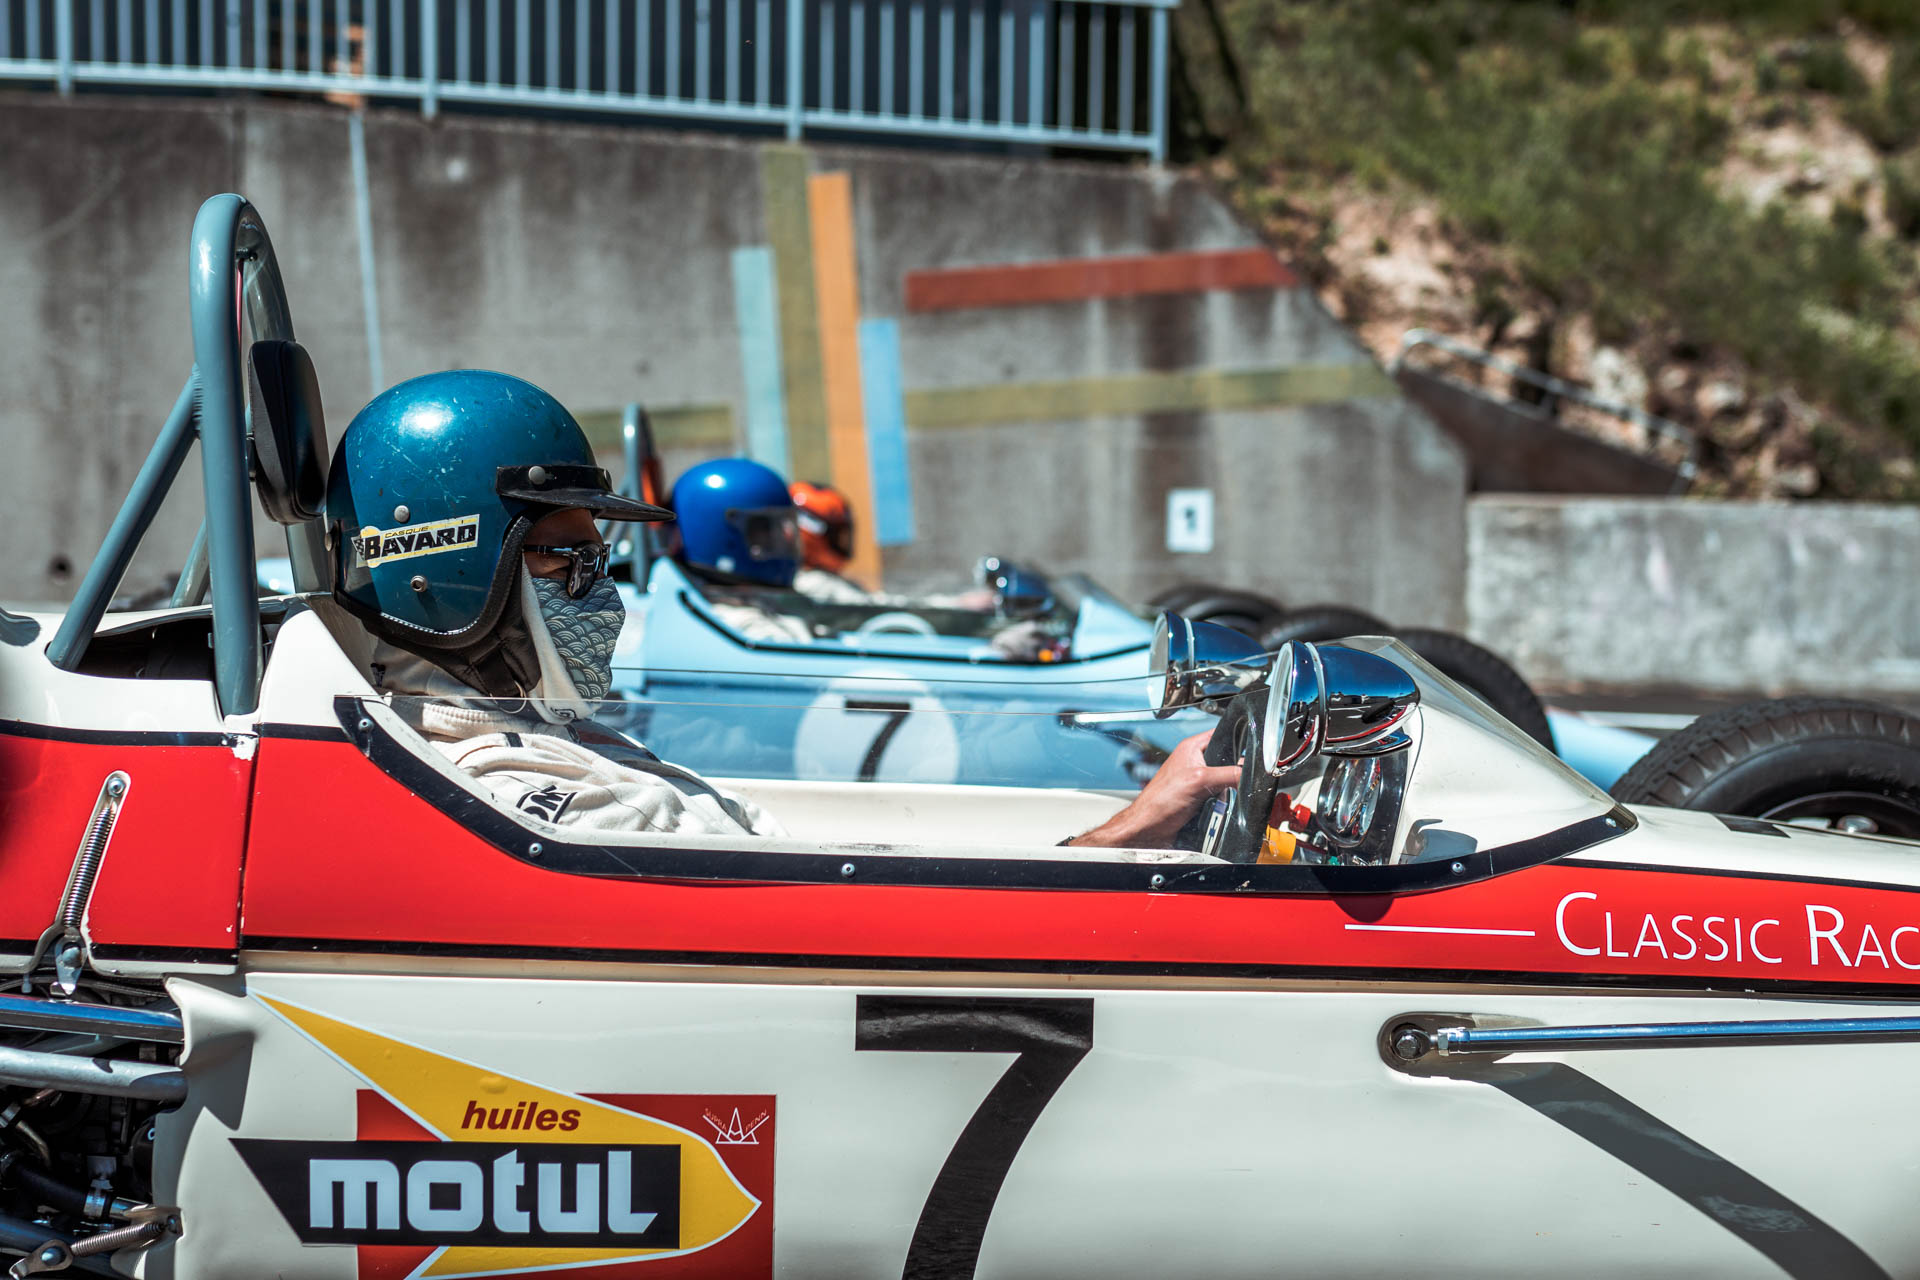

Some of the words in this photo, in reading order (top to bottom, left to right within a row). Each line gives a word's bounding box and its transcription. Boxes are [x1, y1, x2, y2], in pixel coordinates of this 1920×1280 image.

[364, 524, 477, 561] BAYARD
[384, 525, 430, 538] CASQUE
[843, 697, 912, 782] 7
[1555, 891, 1783, 964] CLASSIC
[1805, 904, 1920, 970] RAC
[461, 1100, 582, 1131] huiles
[855, 994, 1094, 1280] 7
[309, 1149, 658, 1234] motul
